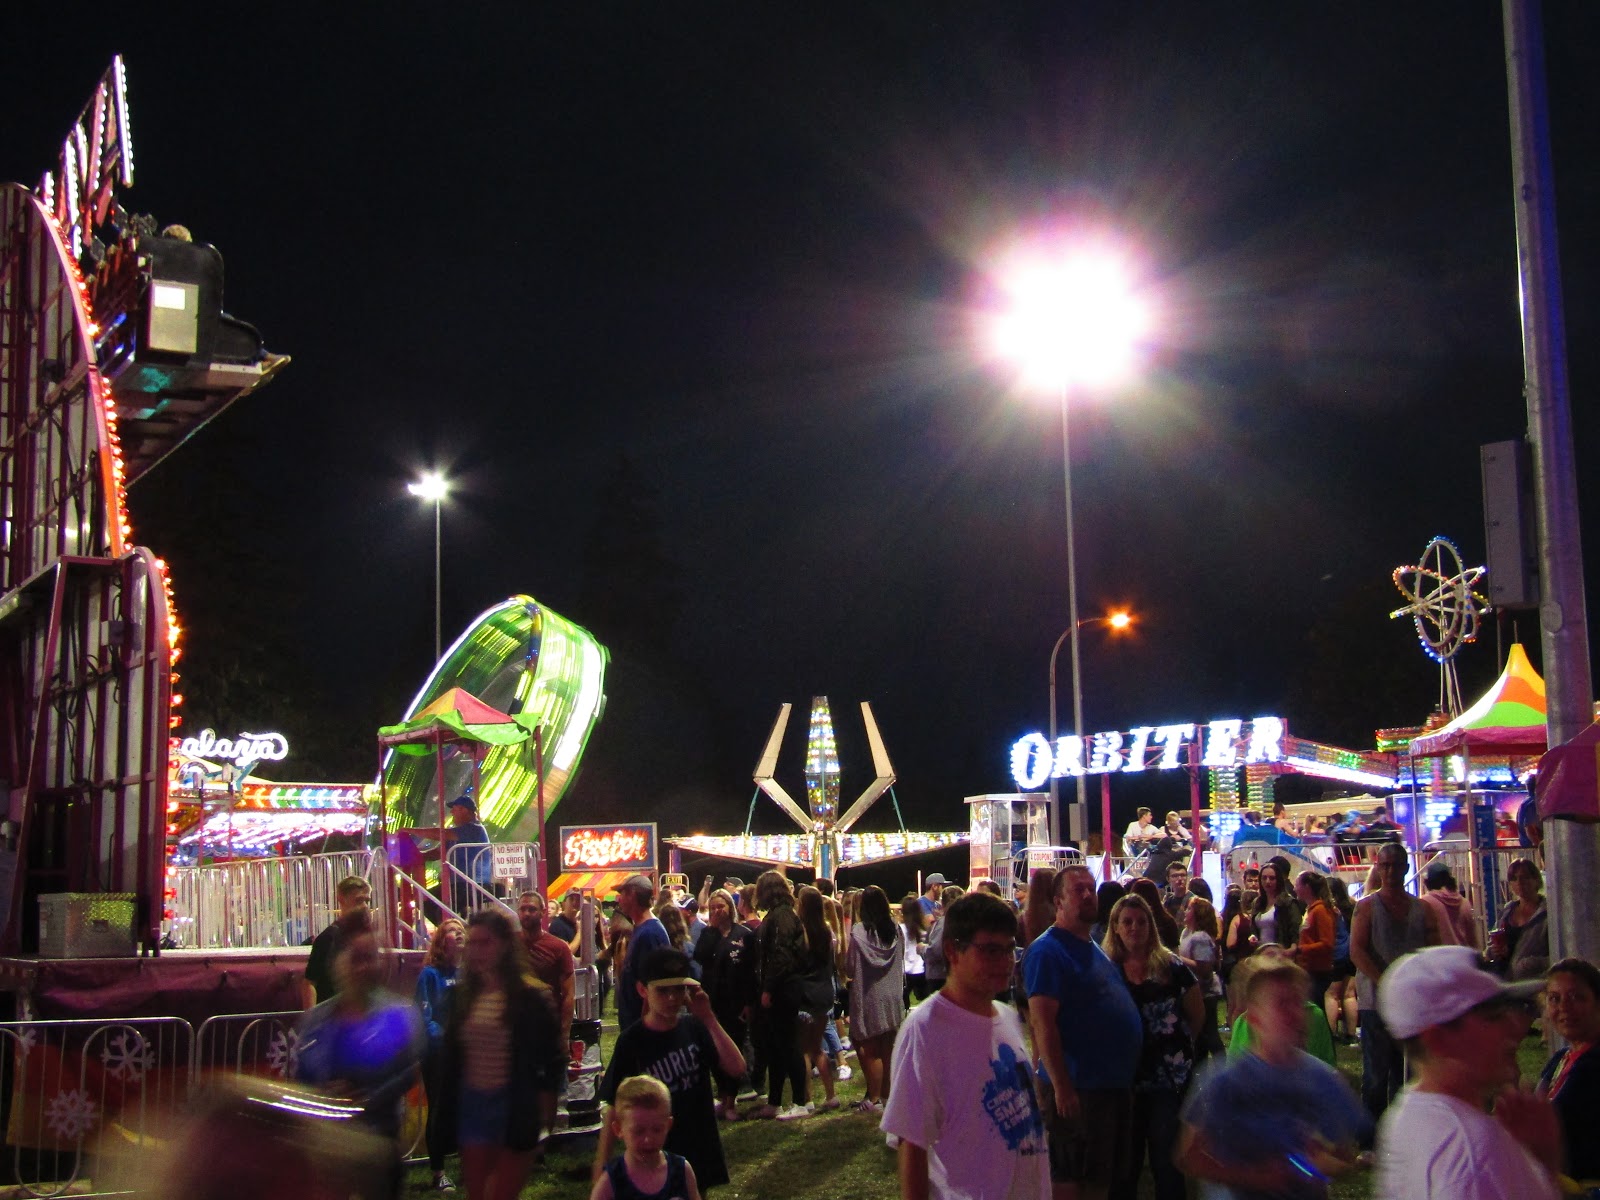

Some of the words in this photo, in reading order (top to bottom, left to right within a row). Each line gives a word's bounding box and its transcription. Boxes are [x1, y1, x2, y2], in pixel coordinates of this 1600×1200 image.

[1010, 717, 1285, 789] ORBITER
[496, 857, 505, 865] NO
[509, 867, 523, 875] RIDE
[667, 876, 682, 885] EXIT
